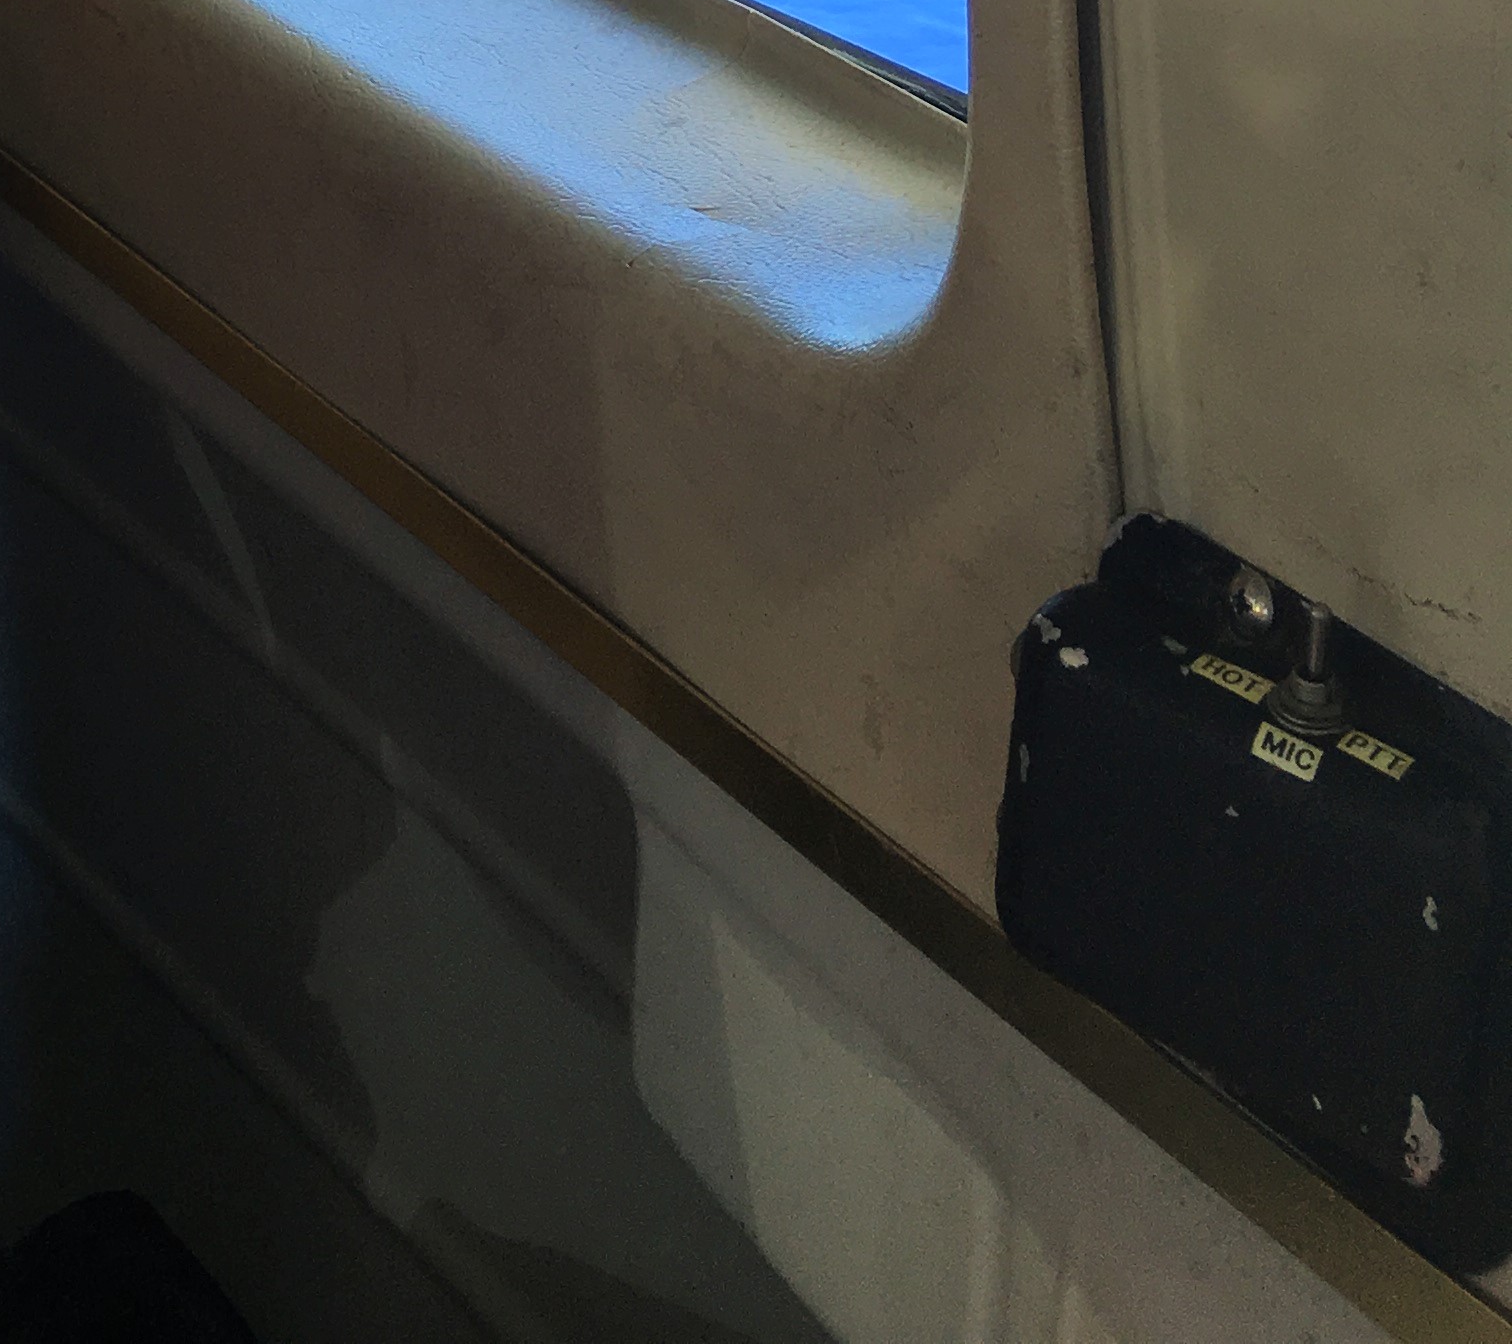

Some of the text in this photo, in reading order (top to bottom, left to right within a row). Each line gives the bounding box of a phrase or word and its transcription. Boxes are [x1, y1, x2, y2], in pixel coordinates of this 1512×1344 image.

[1201, 658, 1259, 693] HOT
[1260, 731, 1316, 772] MIC
[1344, 733, 1407, 771] PTT
